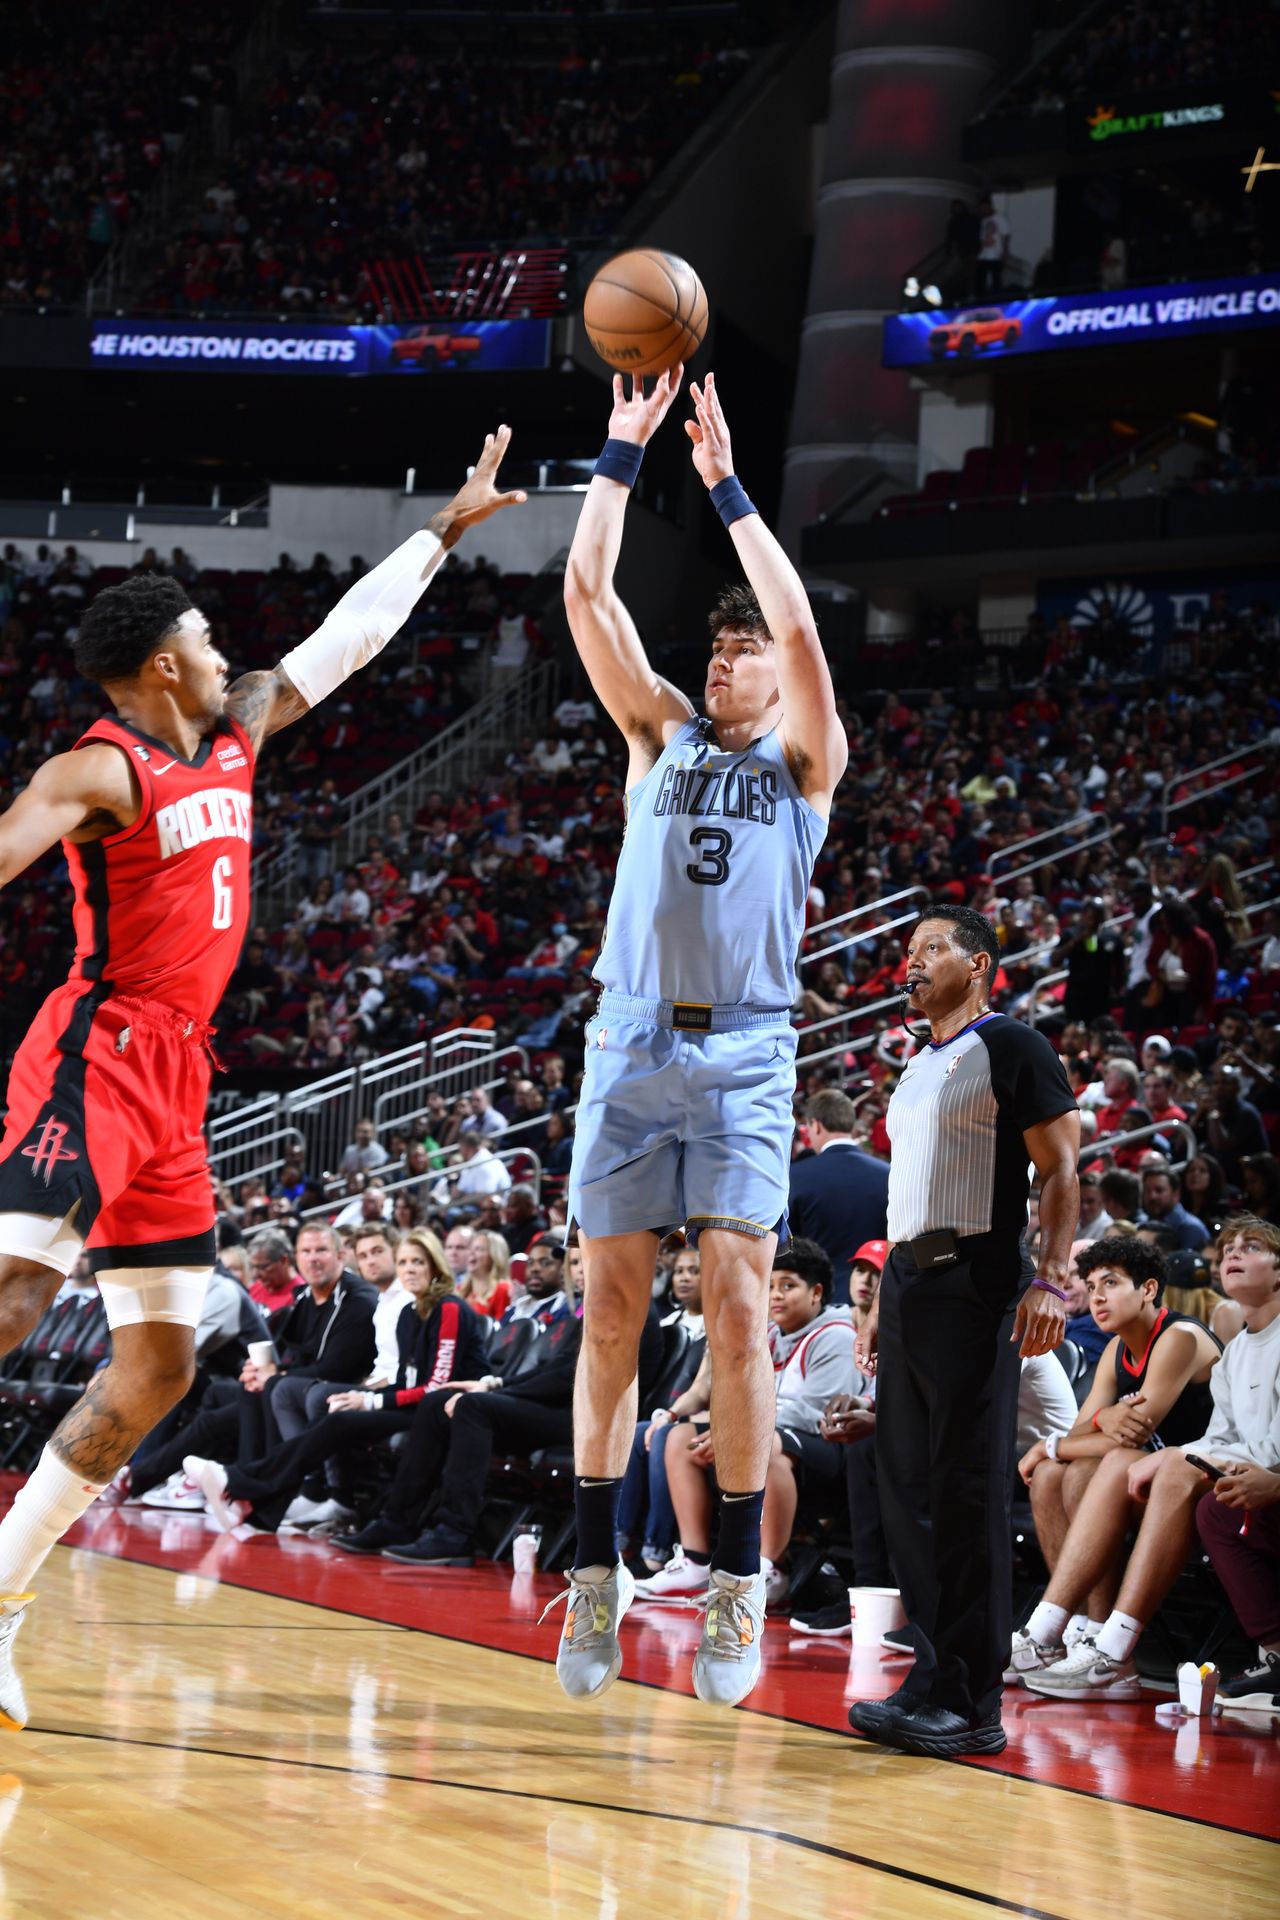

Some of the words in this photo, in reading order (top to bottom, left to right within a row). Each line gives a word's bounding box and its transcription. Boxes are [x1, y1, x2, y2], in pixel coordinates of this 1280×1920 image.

[1047, 303, 1153, 335] OFFICIAL
[1155, 291, 1256, 323] VEHICLE
[119, 335, 241, 358] HOUSTON
[242, 338, 356, 362] ROCKETS
[653, 764, 777, 826] GRIZZLIES
[686, 826, 733, 886] 3
[211, 855, 233, 930] 6
